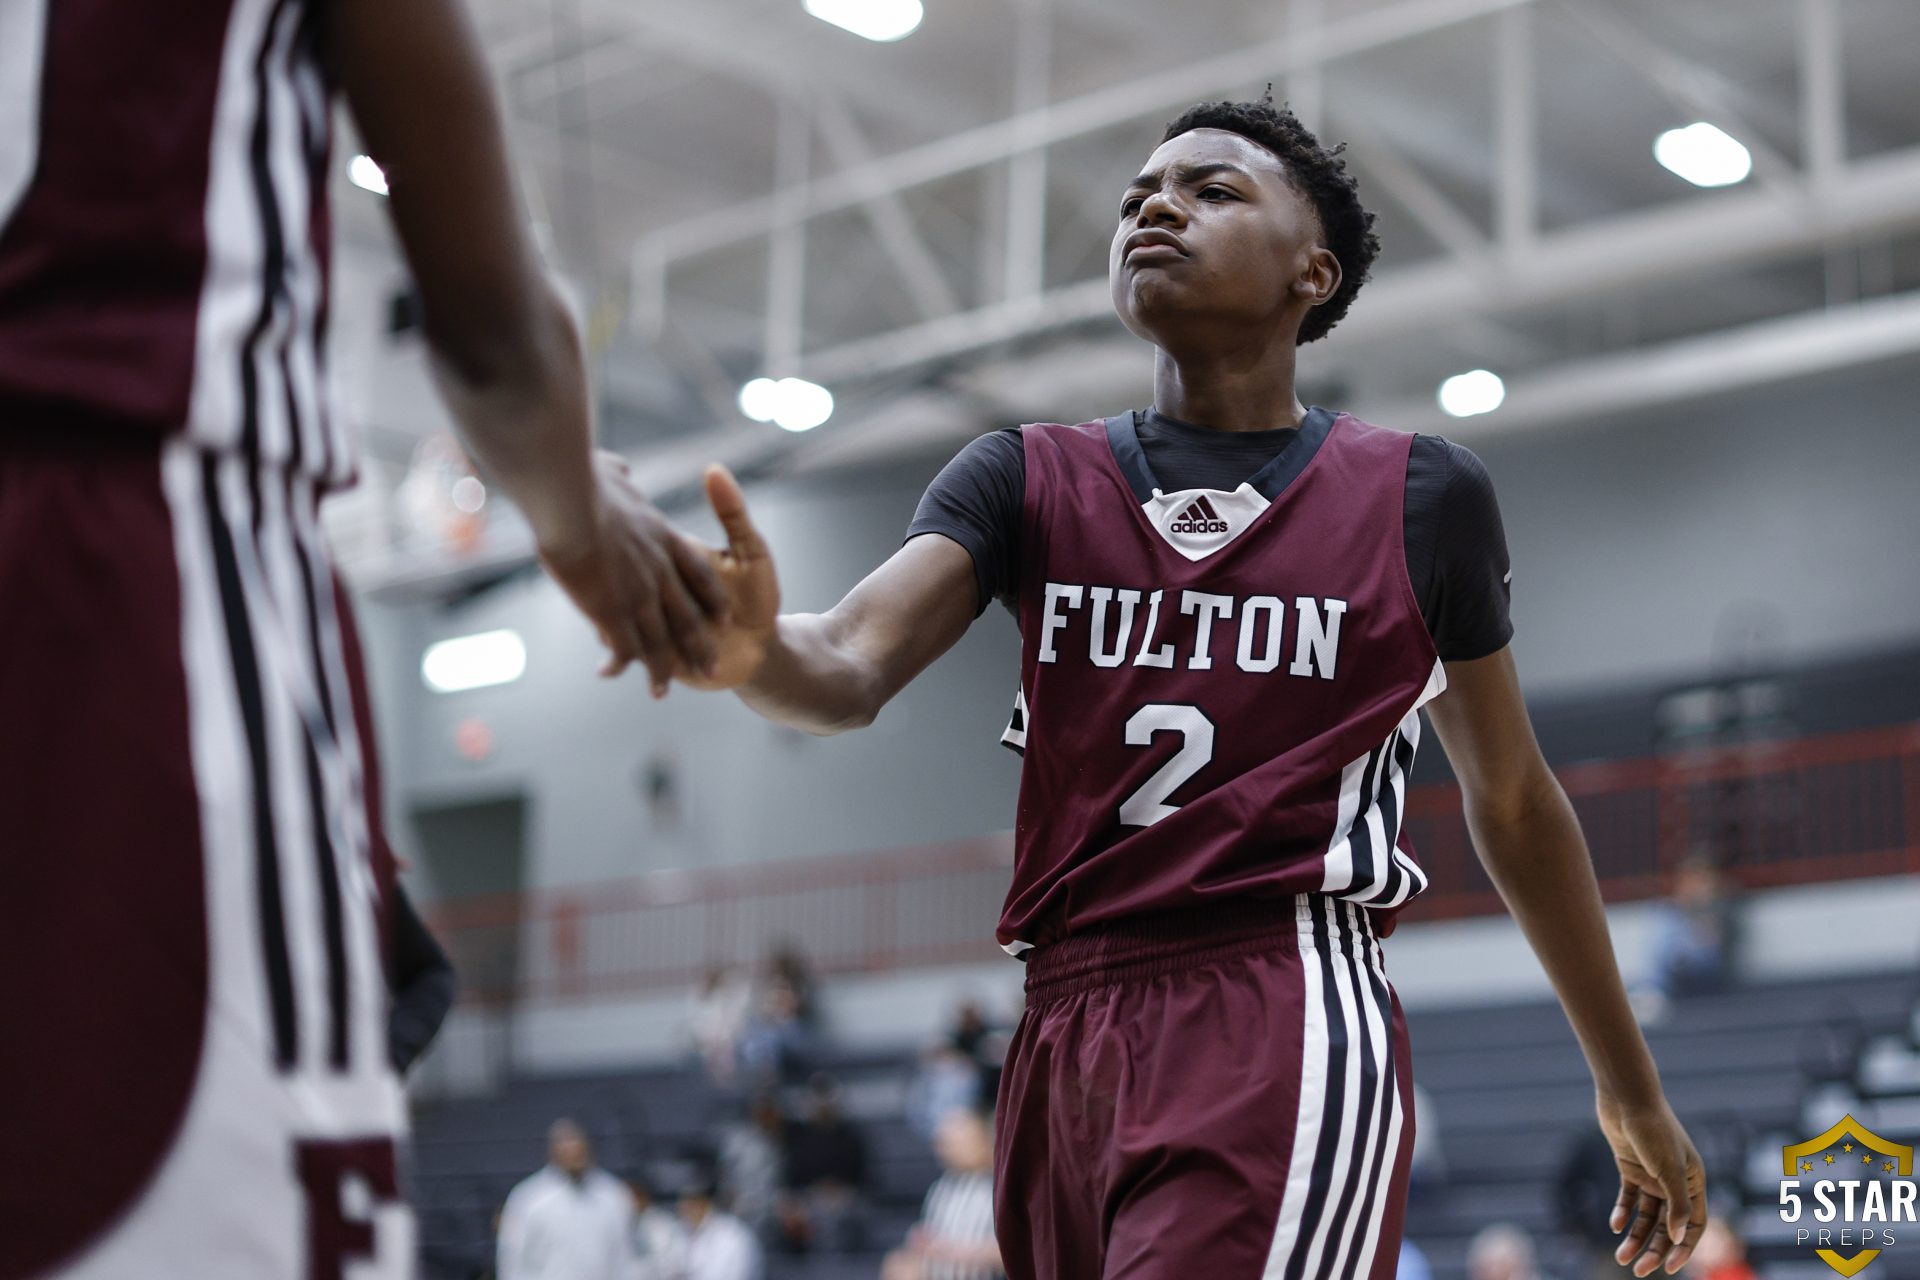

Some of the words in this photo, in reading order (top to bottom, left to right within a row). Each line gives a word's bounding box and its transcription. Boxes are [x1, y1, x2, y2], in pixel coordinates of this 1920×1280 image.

[1170, 519, 1229, 533] adidas
[1038, 582, 1347, 680] FULTON
[1119, 704, 1215, 827] 2
[292, 1136, 399, 1280] F
